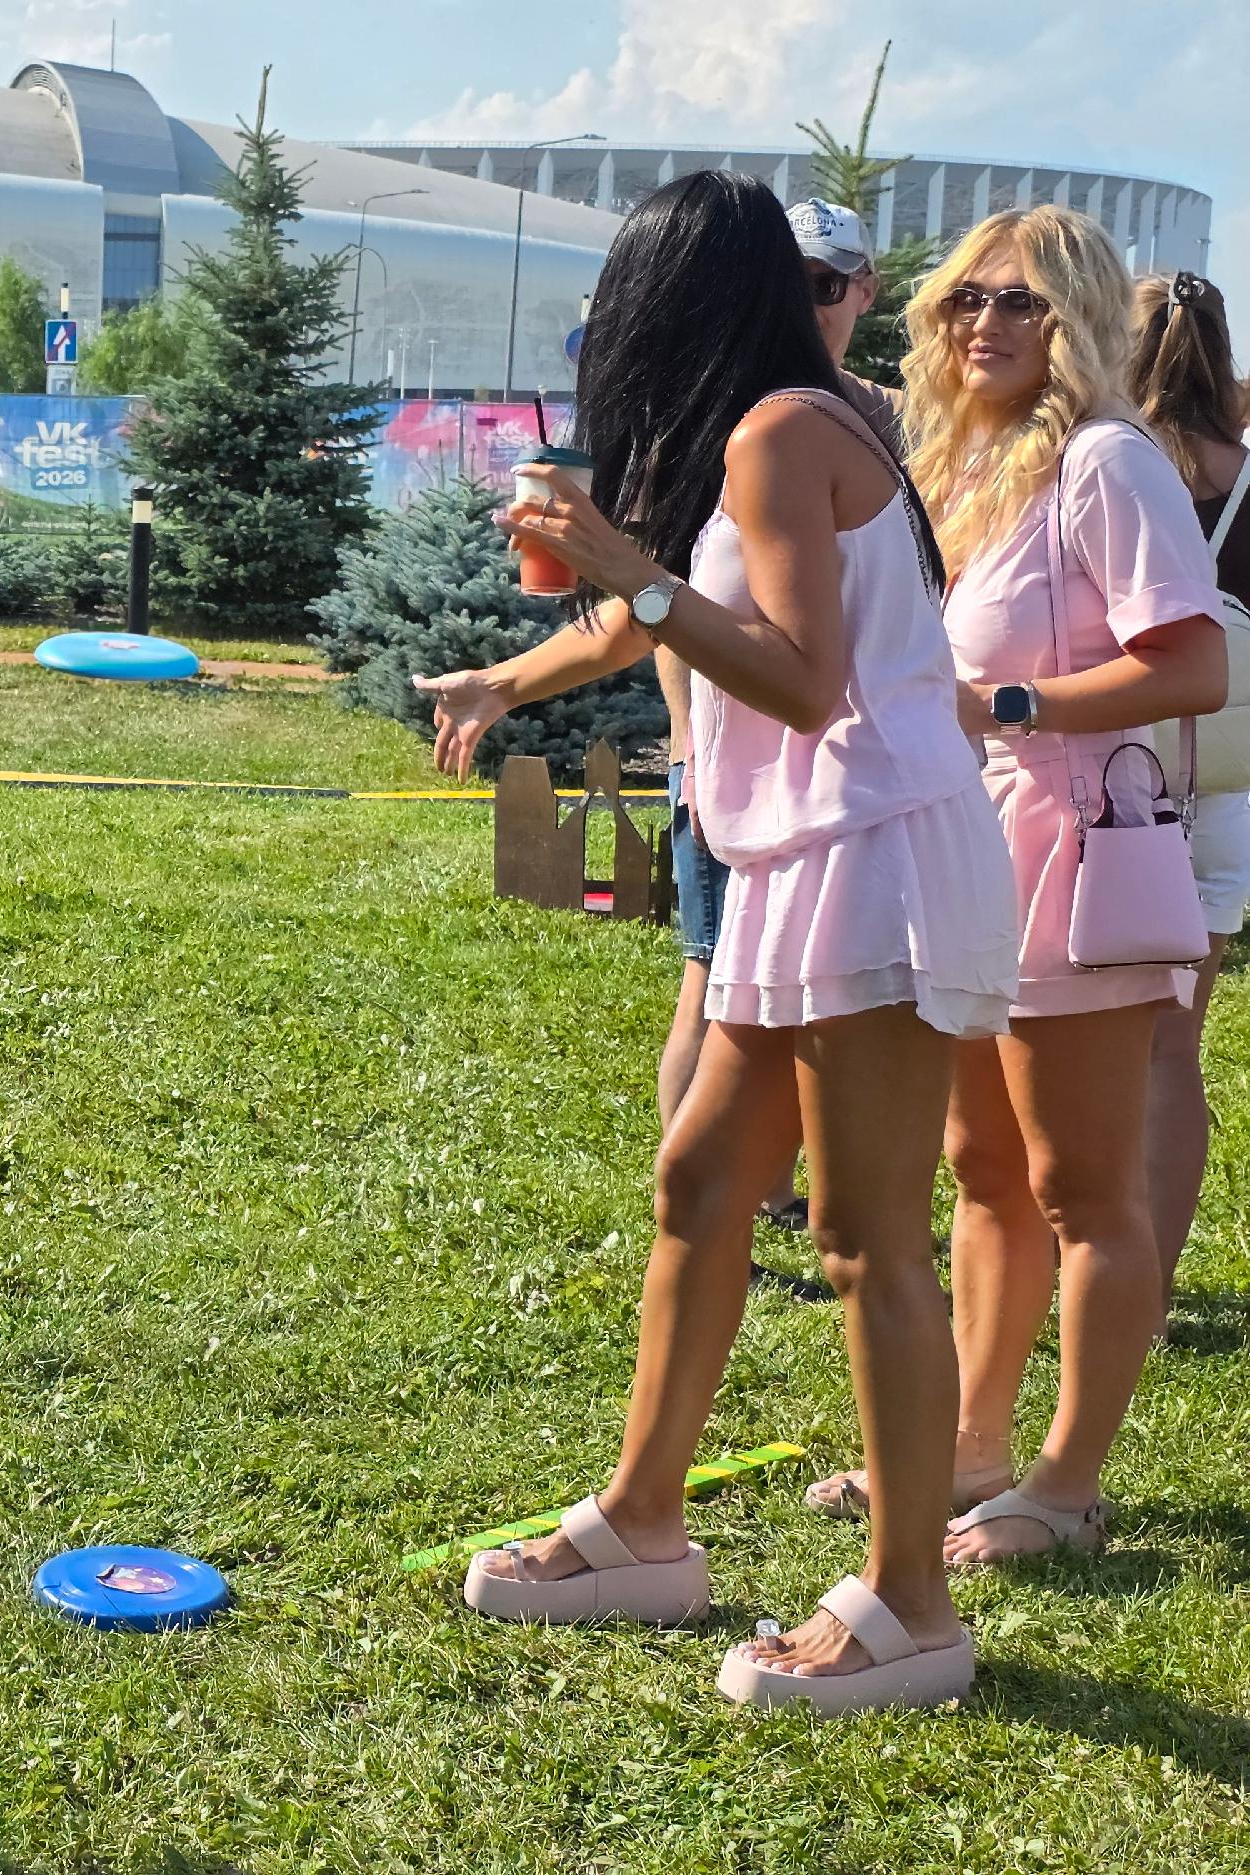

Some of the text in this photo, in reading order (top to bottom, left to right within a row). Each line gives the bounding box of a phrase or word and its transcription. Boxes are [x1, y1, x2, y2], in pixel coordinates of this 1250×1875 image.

[35, 420, 89, 444] VK
[493, 420, 522, 435] VK
[13, 435, 110, 468] fest
[35, 470, 87, 486] 2026
